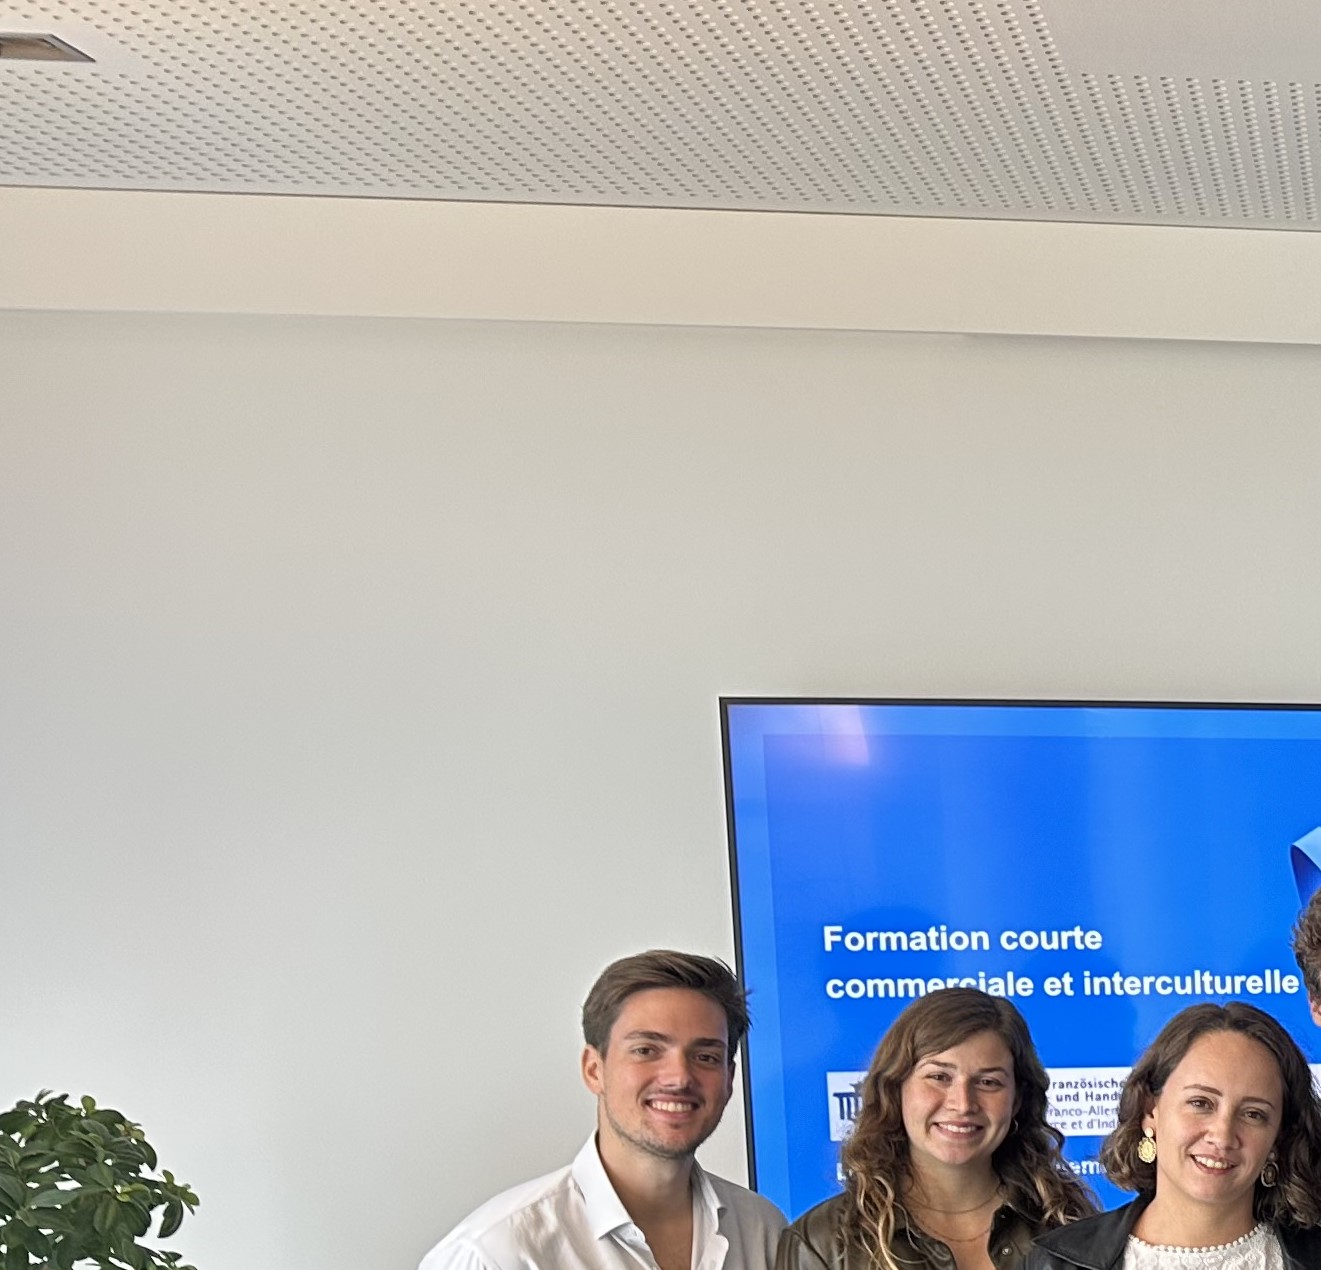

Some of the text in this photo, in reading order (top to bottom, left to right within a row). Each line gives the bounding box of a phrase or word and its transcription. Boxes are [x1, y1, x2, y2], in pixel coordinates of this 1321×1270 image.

[823, 925, 1103, 952] Formation courte
[1046, 971, 1074, 996] et
[1083, 969, 1299, 996] interculturelle
[1056, 1091, 1119, 1102] und Hand
